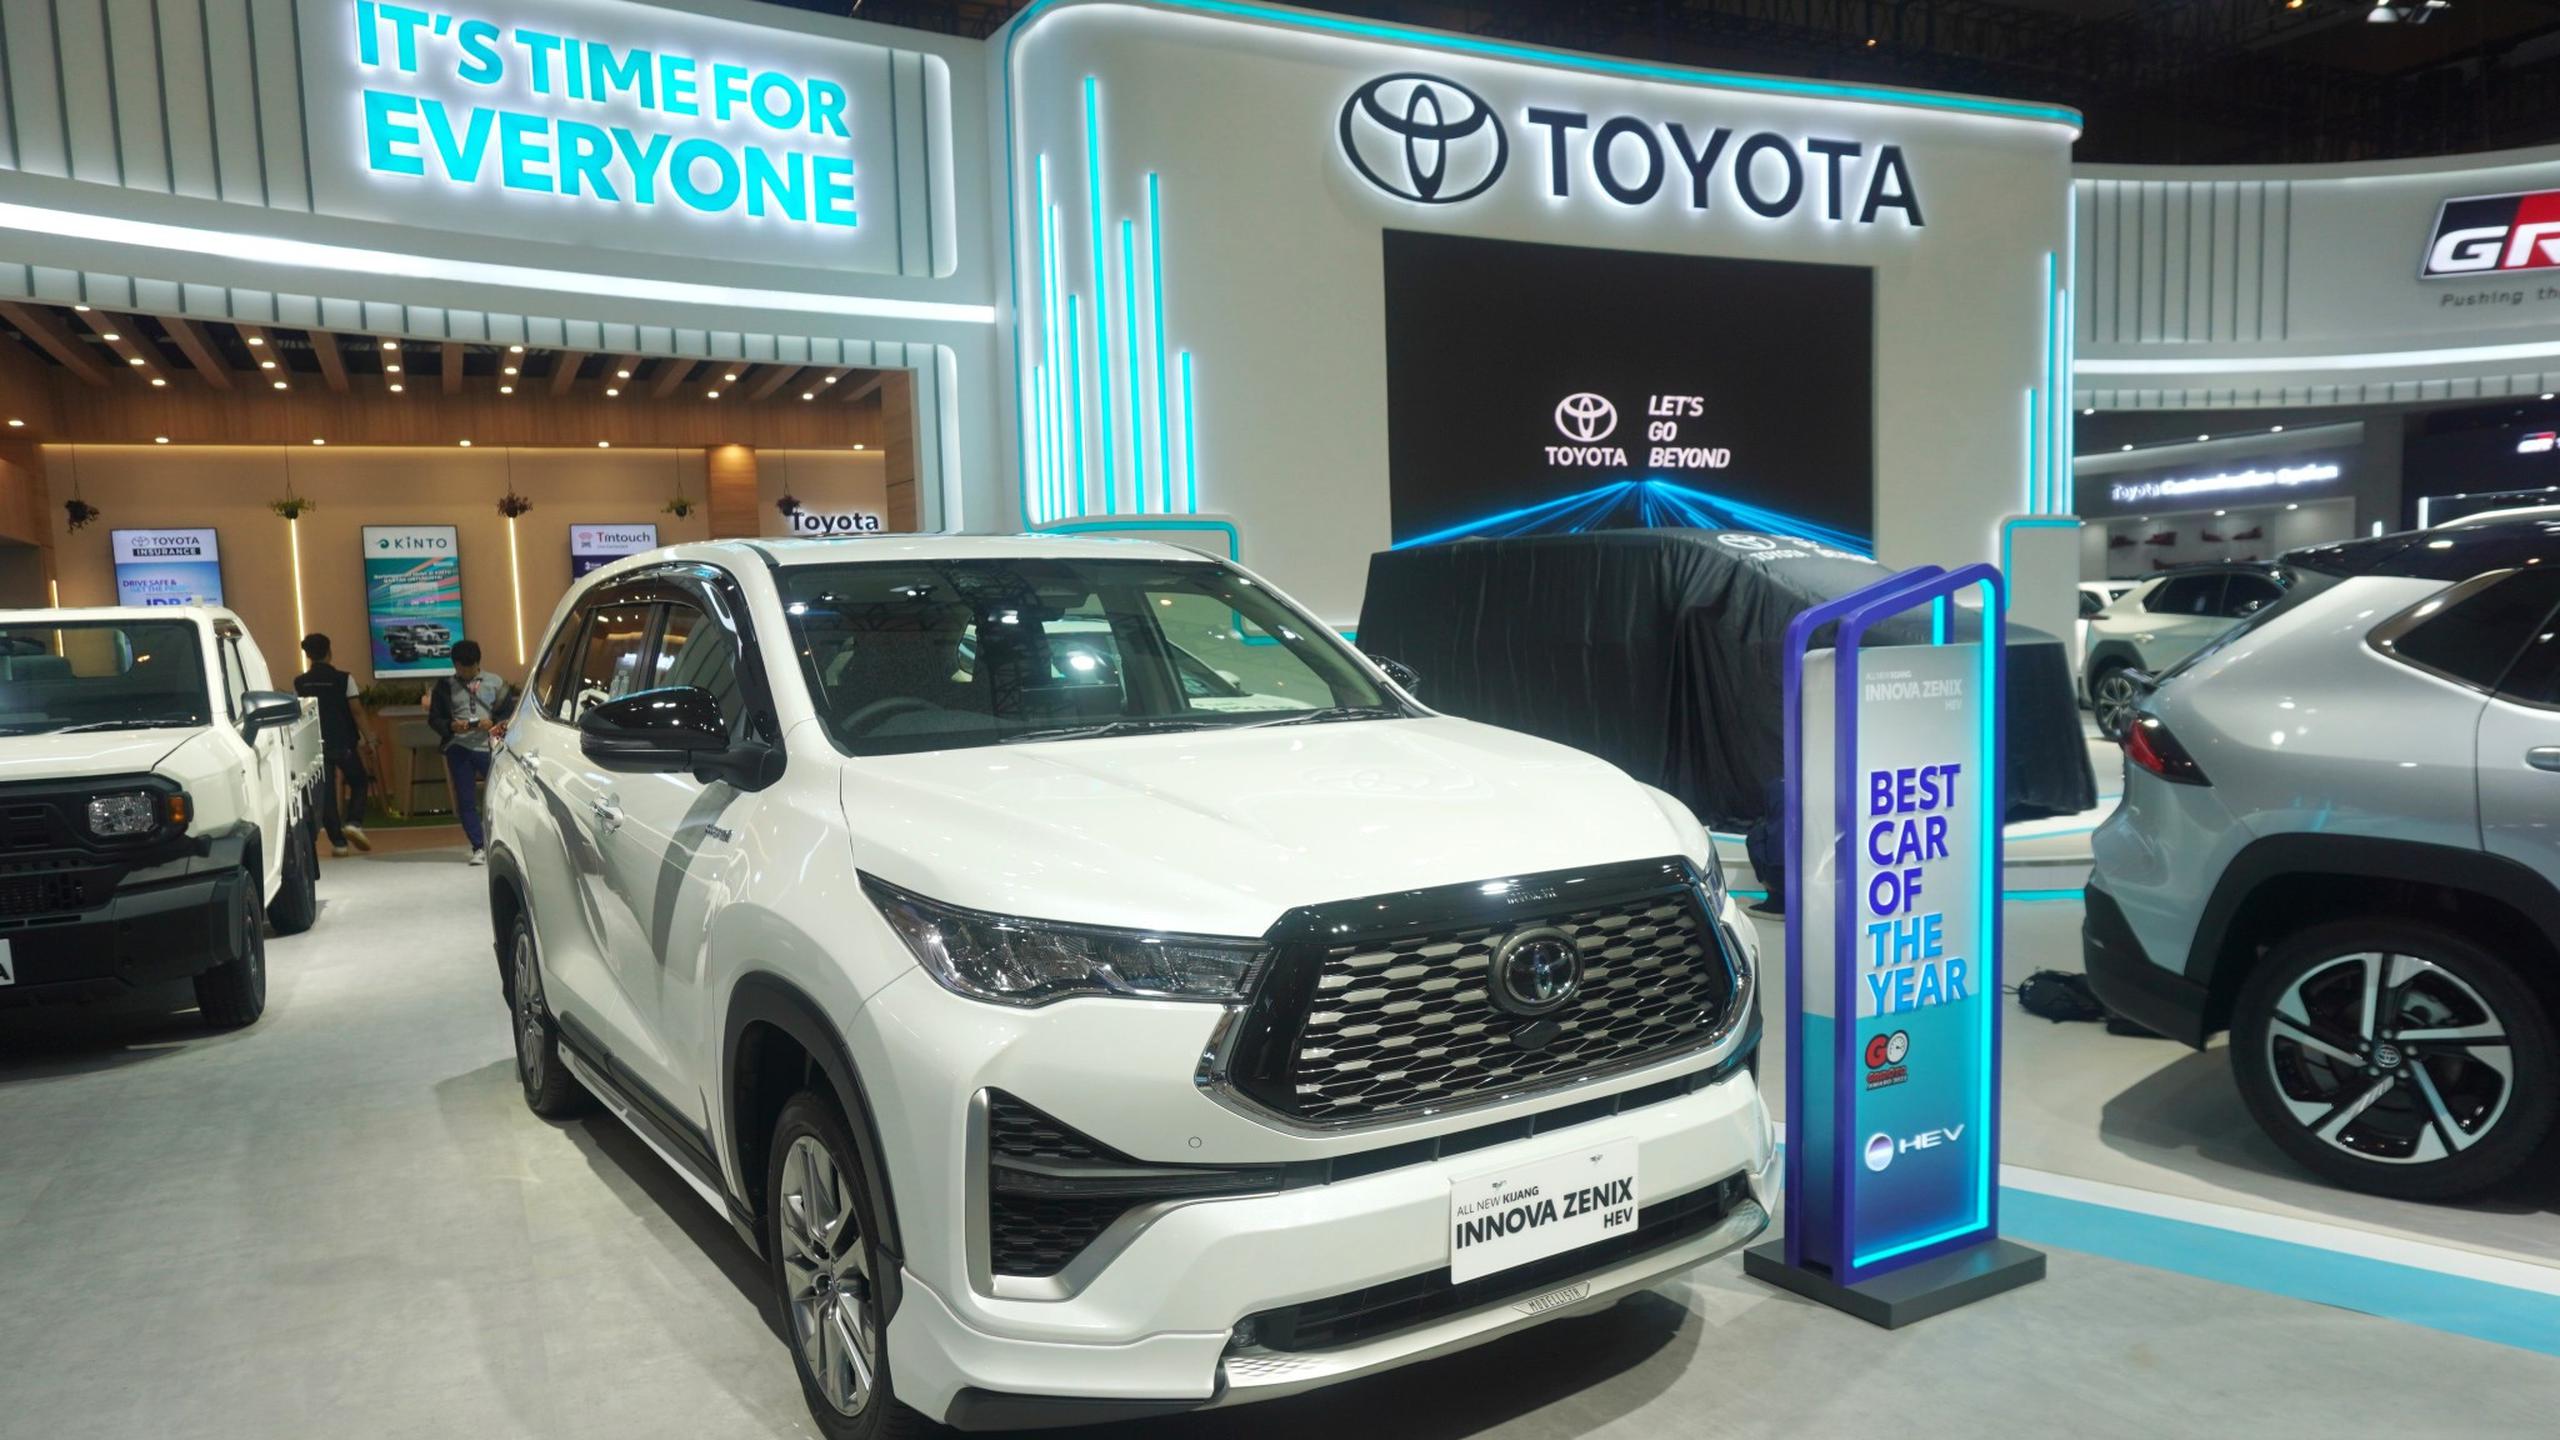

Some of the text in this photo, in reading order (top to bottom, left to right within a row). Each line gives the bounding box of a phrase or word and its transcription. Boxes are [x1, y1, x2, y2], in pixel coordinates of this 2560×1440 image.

[357, 0, 852, 138] IT'S TIME FOR
[363, 89, 858, 228] EVERYONE
[1527, 106, 1926, 227] TOYOTA
[2440, 286, 2560, 307] Pushing th
[1648, 395, 1705, 417] LET'S
[1648, 421, 1678, 442] GO
[1544, 446, 1629, 467] TOYOTA
[1648, 447, 1731, 469] BEYOND
[792, 511, 880, 533] Toyota
[136, 547, 197, 556] INSURANCE
[152, 536, 200, 546] TOYOTA
[1864, 679, 1963, 702] INNOVA ZENIX
[1870, 763, 1961, 816] BEST
[1868, 815, 1949, 866] CAR
[1868, 867, 1923, 917] OF
[1867, 913, 1943, 968] THE
[1866, 958, 1969, 1018] YEAR
[1899, 1123, 1965, 1155] HEV
[1456, 1185, 1540, 1217] ALL NEW KIJANG
[1456, 1176, 1634, 1250] INNOVA ZENIX
[1603, 1206, 1634, 1229] HEV
